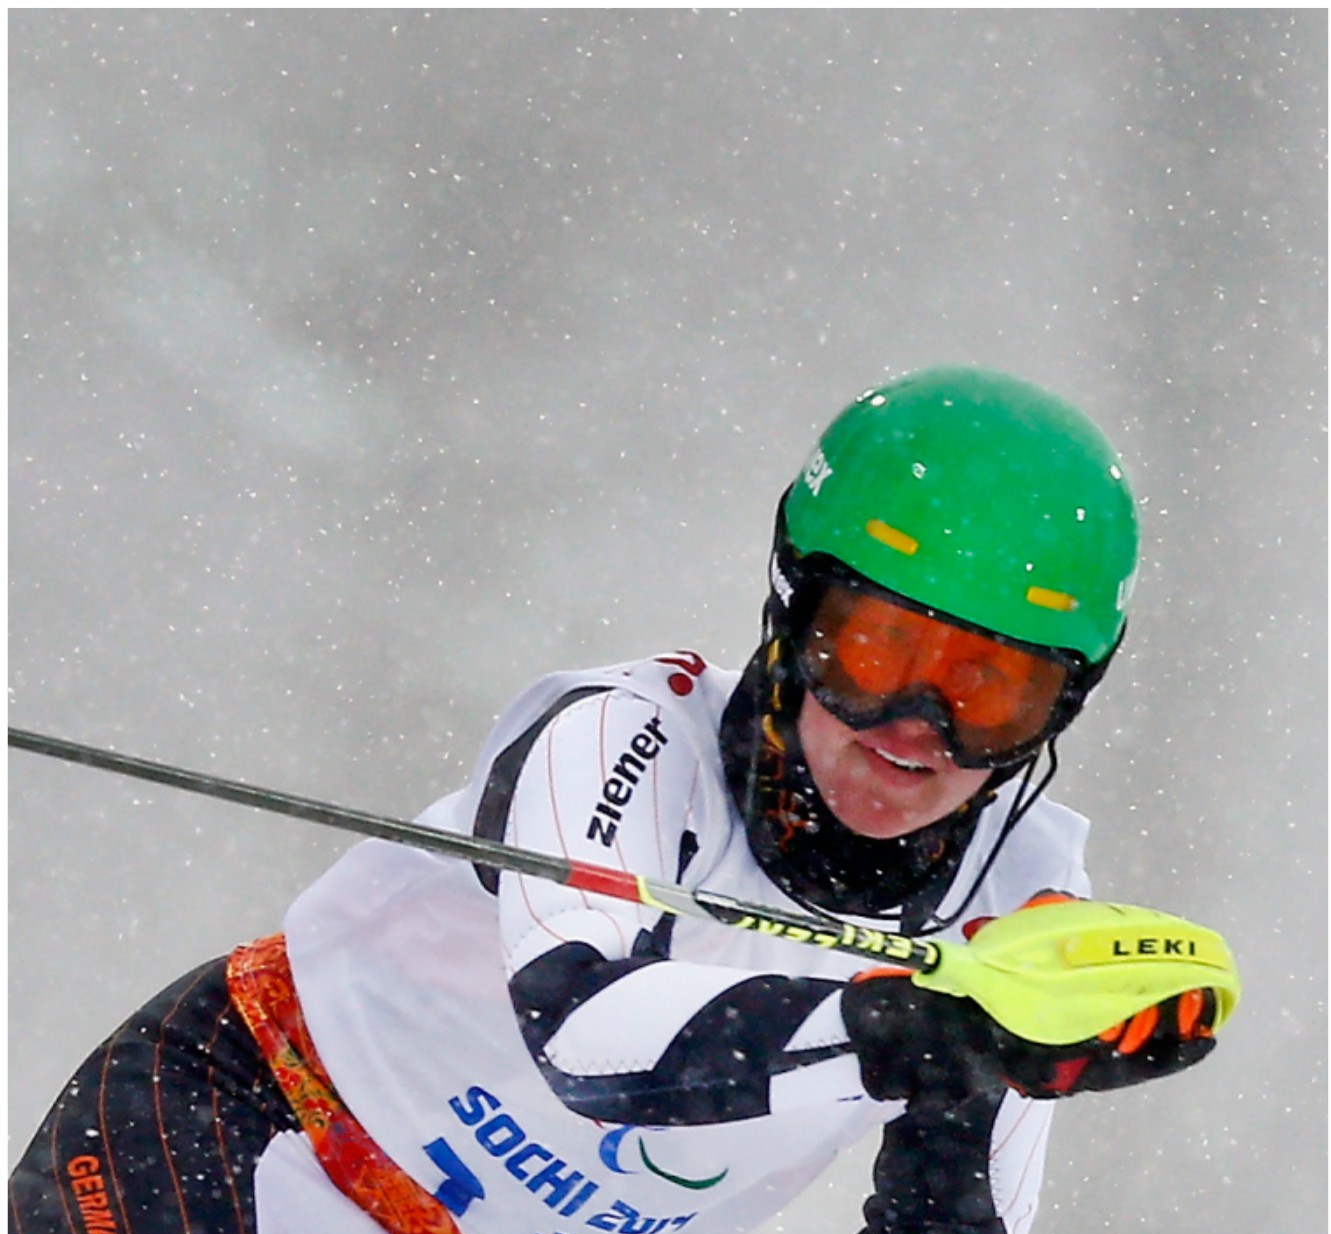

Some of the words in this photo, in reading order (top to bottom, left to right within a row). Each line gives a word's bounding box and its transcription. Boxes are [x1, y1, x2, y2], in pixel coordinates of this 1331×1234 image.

[586, 716, 668, 847] ziener
[1112, 938, 1196, 956] LEKI
[448, 1086, 599, 1217] SOCHI
